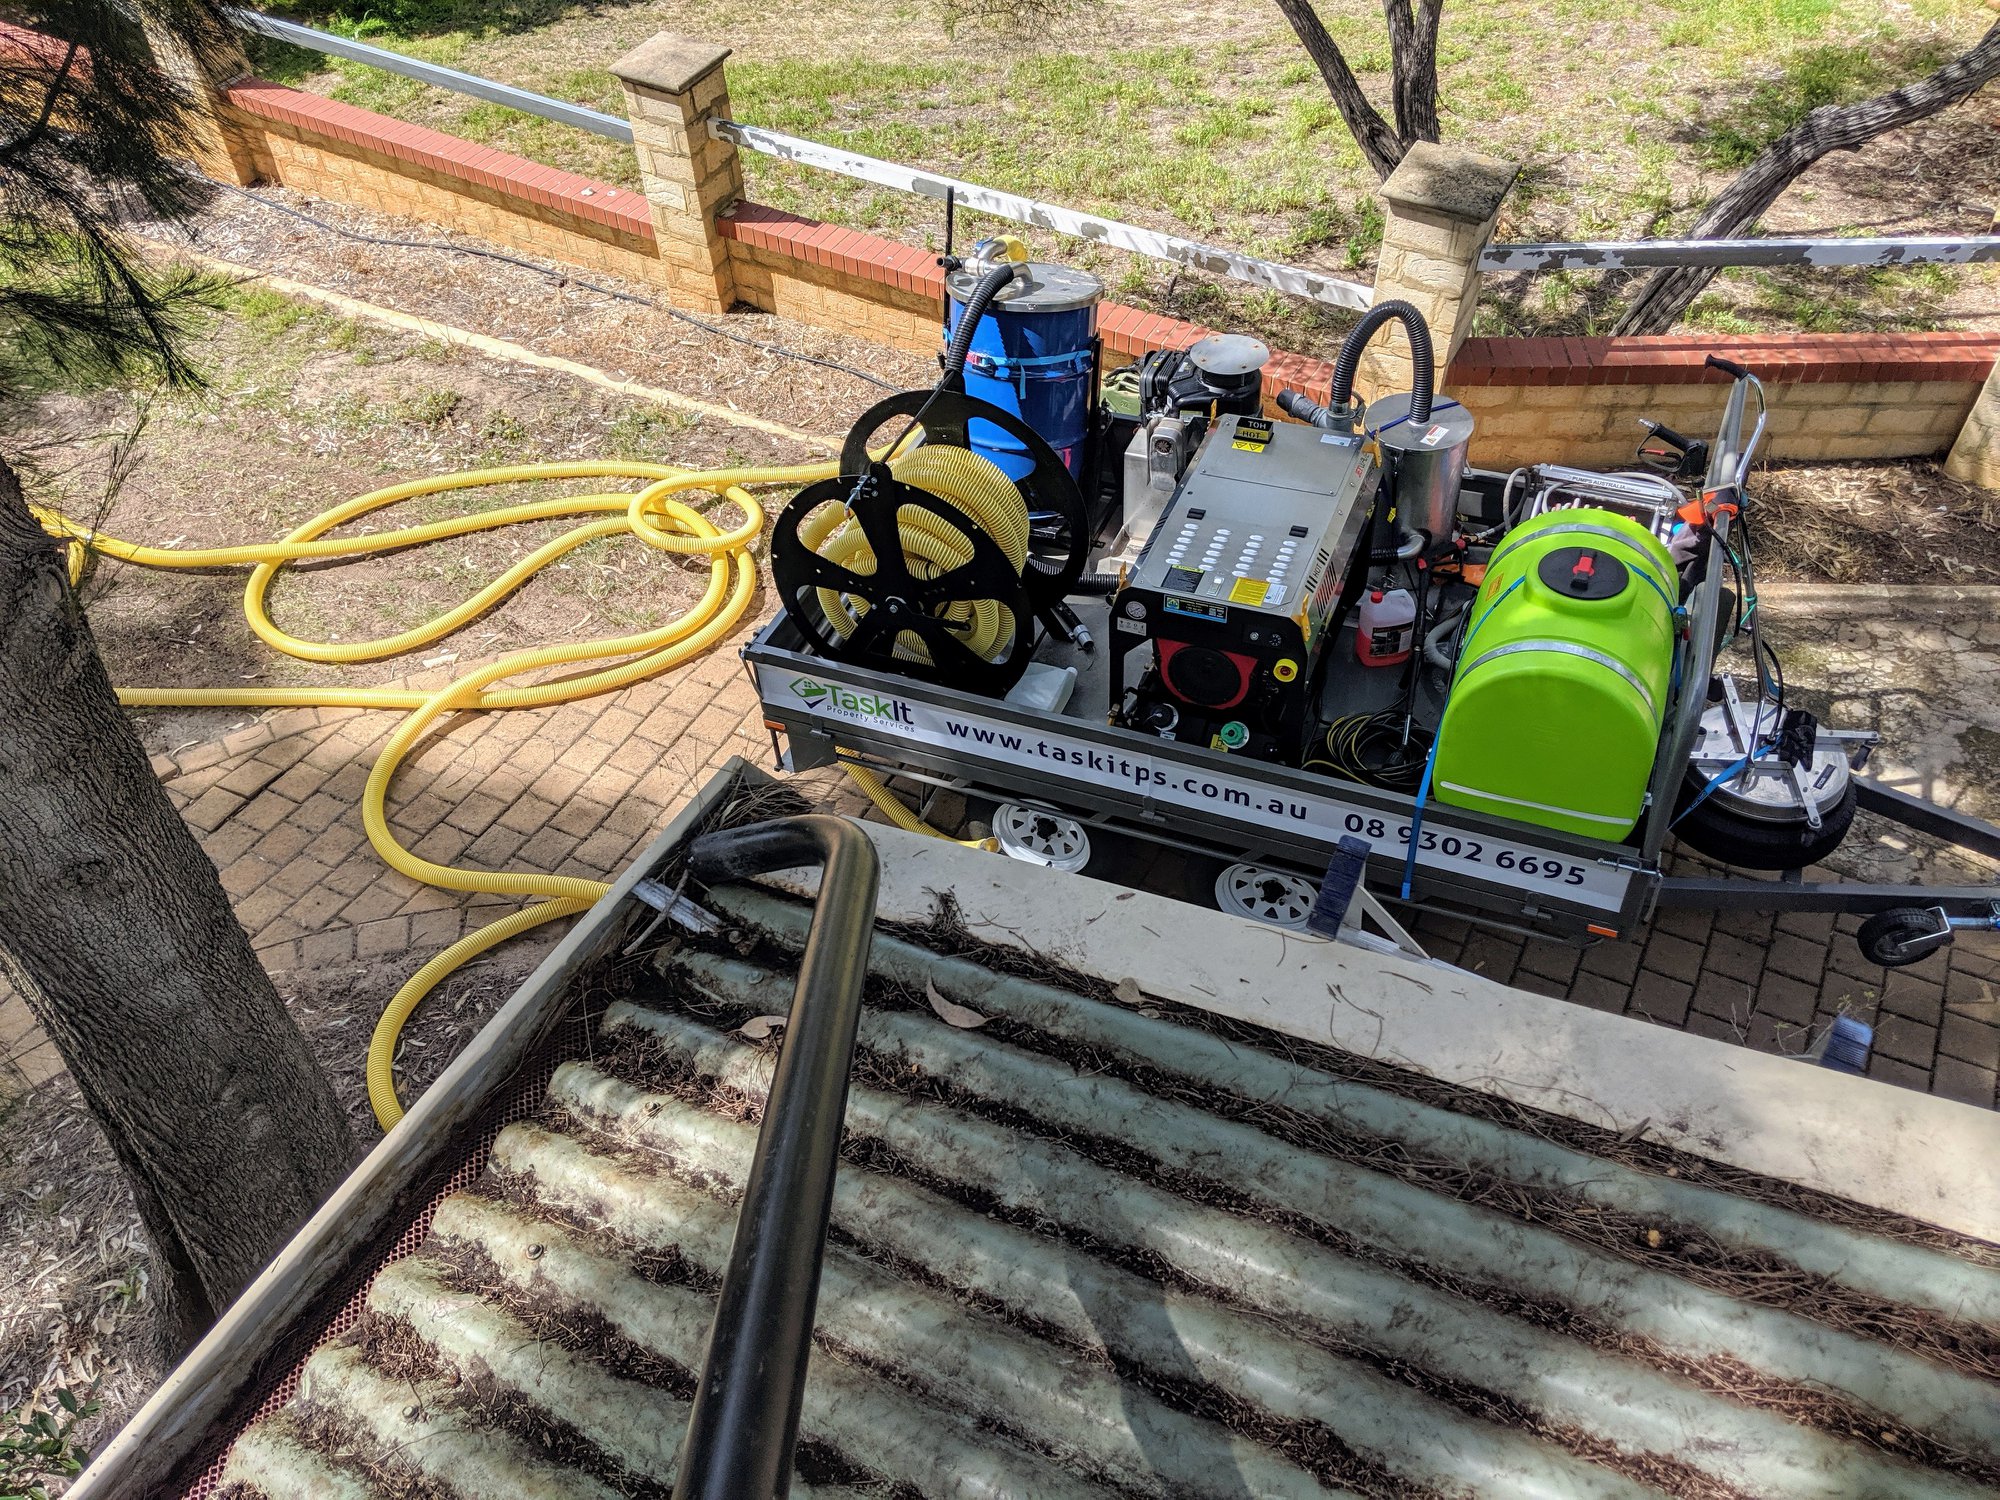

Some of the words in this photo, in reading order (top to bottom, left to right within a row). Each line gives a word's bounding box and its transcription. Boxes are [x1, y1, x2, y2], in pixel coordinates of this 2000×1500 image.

[1242, 430, 1261, 439] HOT
[1572, 475, 1593, 485] PUMPS
[1593, 479, 1626, 490] AUSTRALIA
[1312, 563, 1323, 578] HOT
[873, 716, 915, 733] Services
[946, 720, 1308, 821] www.taskitps.com.au
[1344, 813, 1386, 839] 08
[1397, 825, 1484, 863] 9302
[1495, 850, 1587, 887] 6695
